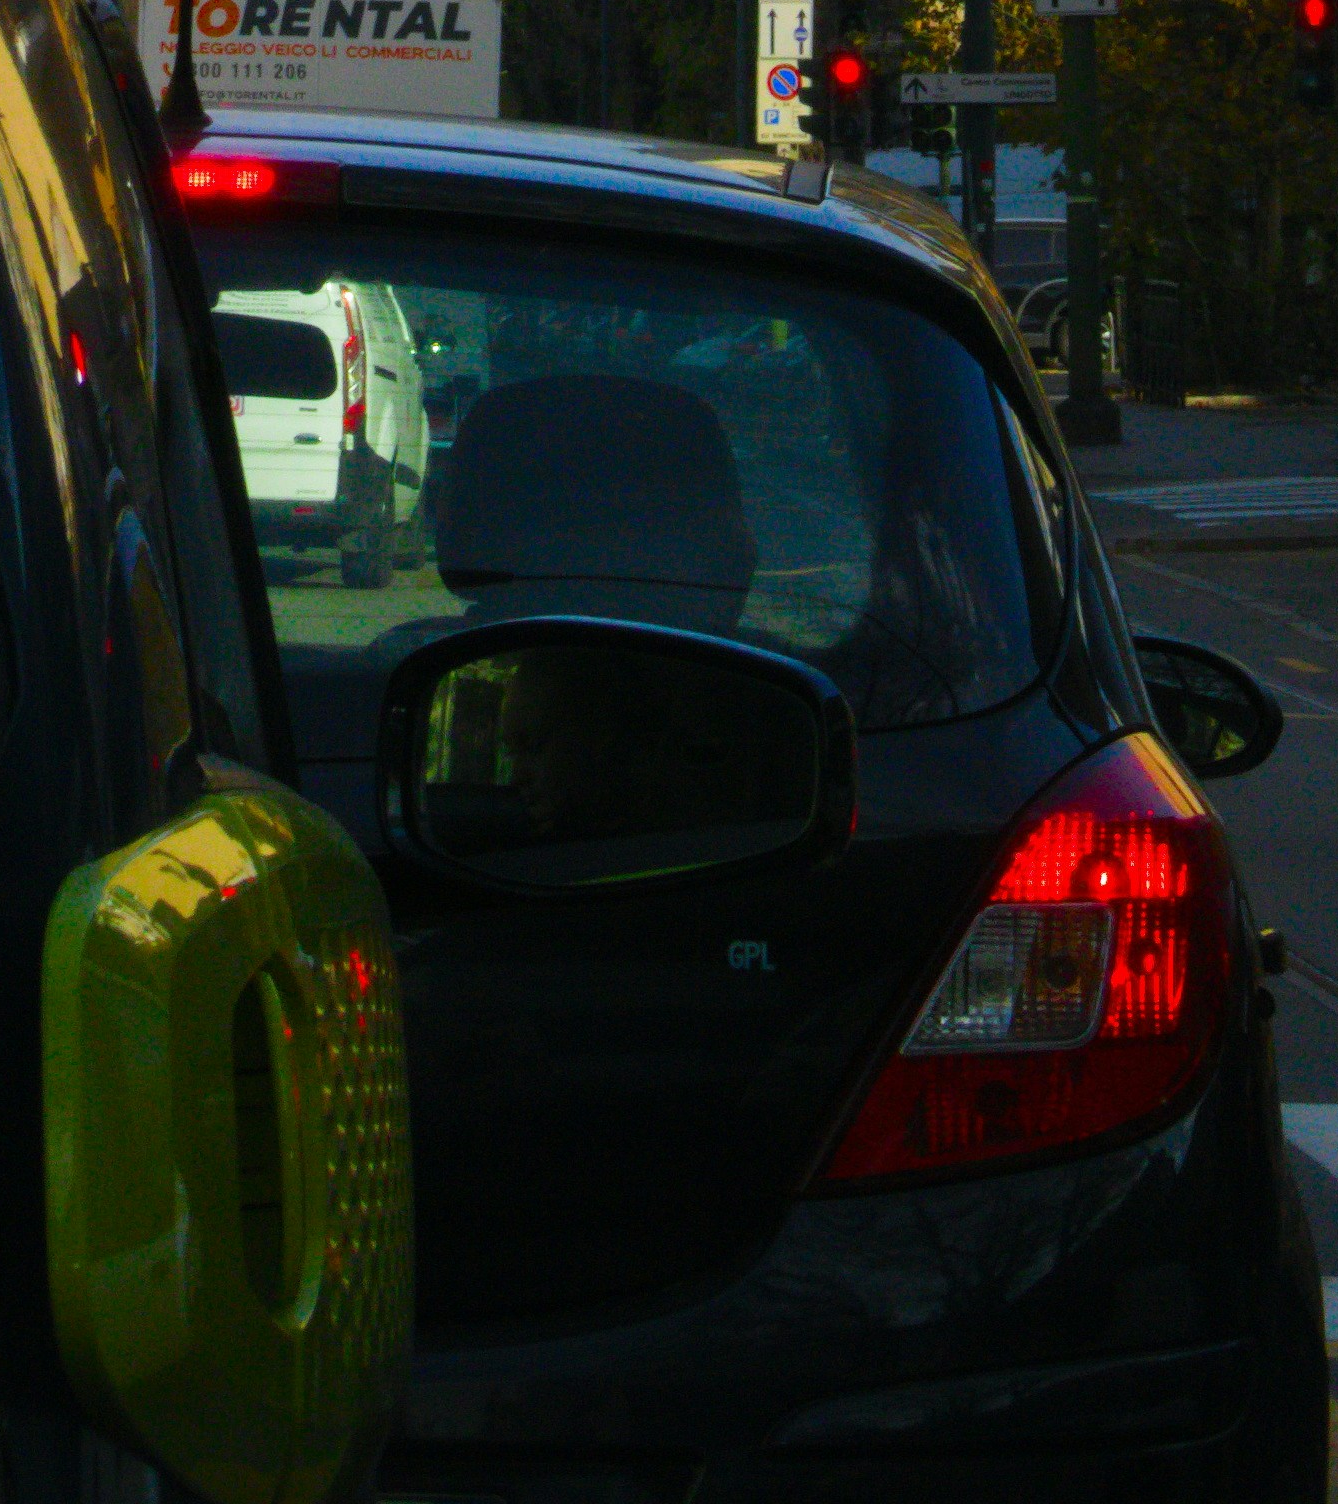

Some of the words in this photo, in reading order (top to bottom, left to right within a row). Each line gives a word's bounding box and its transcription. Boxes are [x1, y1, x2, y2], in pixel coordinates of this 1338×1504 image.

[345, 46, 472, 61] COMMERCIALI
[232, 63, 262, 78] 111
[274, 64, 306, 79] 206
[727, 939, 776, 970] GPL
